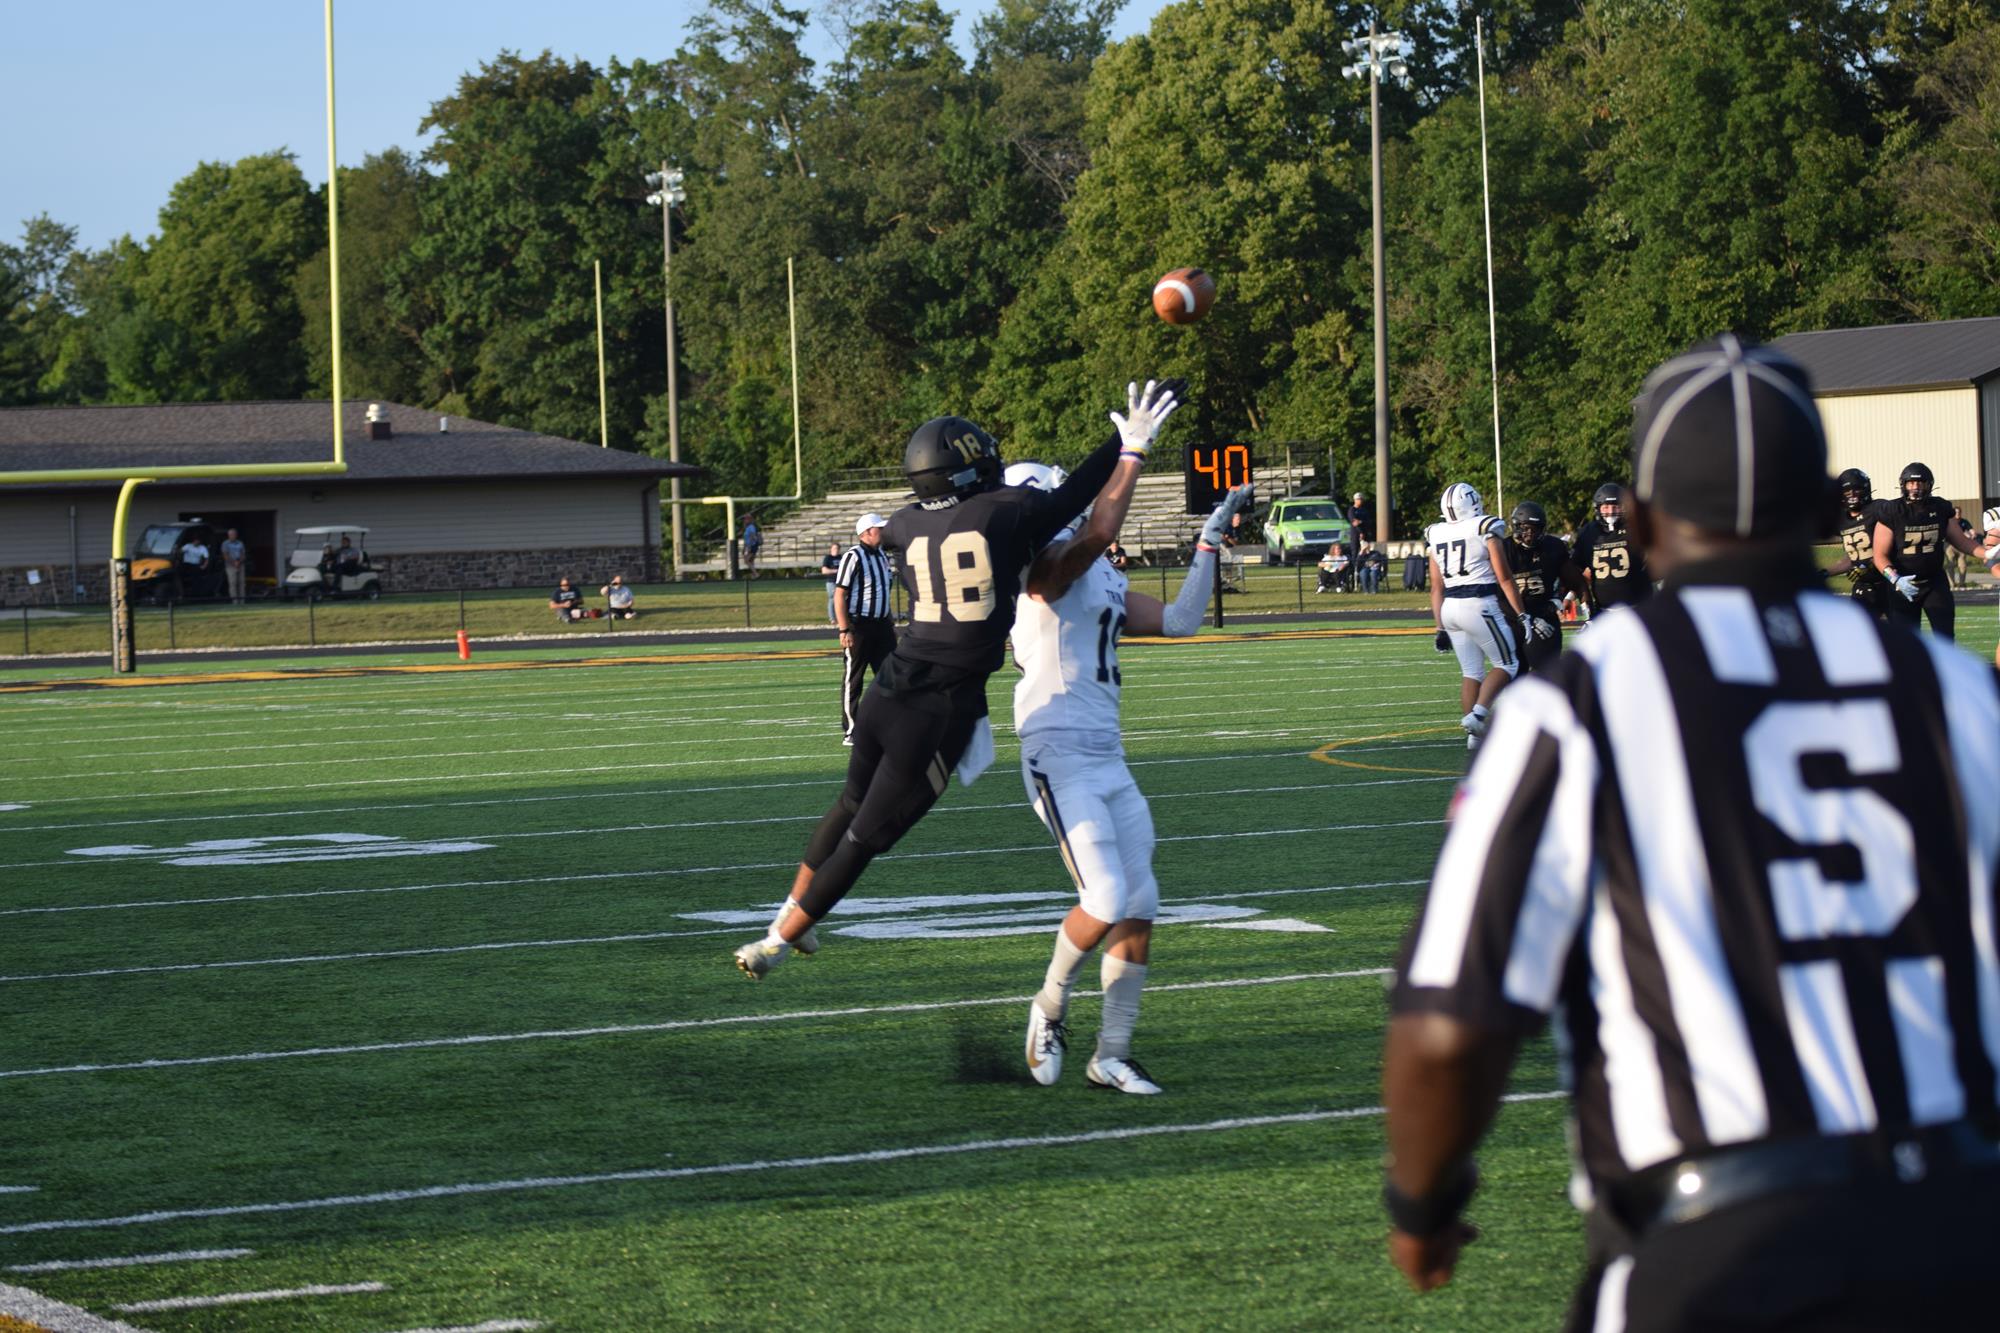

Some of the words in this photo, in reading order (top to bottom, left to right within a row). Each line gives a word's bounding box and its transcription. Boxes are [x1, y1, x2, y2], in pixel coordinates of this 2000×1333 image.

[1194, 445, 1249, 491] 40
[1436, 539, 1470, 579] 77
[1592, 547, 1630, 579] 53
[1903, 530, 1939, 555] 77
[906, 531, 996, 622] 18
[1742, 699, 1920, 941] S
